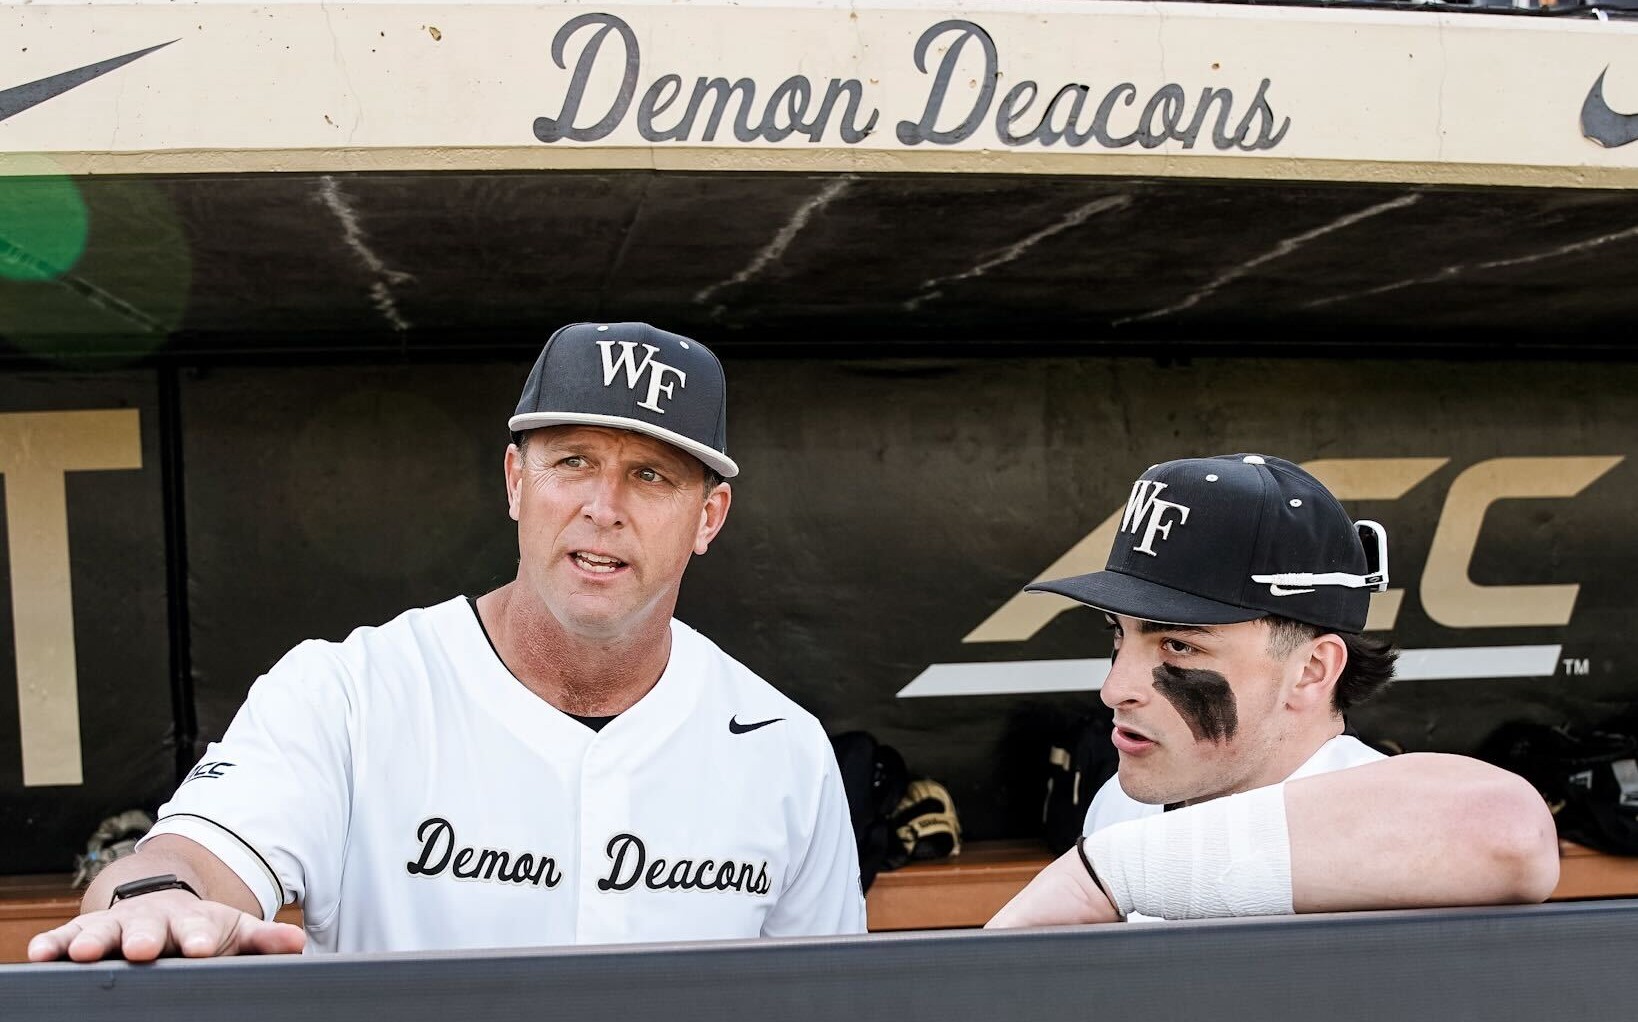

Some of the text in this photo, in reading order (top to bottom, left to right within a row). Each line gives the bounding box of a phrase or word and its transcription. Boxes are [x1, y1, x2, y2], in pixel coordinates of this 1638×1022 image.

[533, 12, 1290, 152] Demon Deacons
[596, 340, 687, 414] WF
[1121, 480, 1191, 557] WF
[1562, 658, 1590, 676] TM
[407, 817, 772, 895] Demon Deacons
